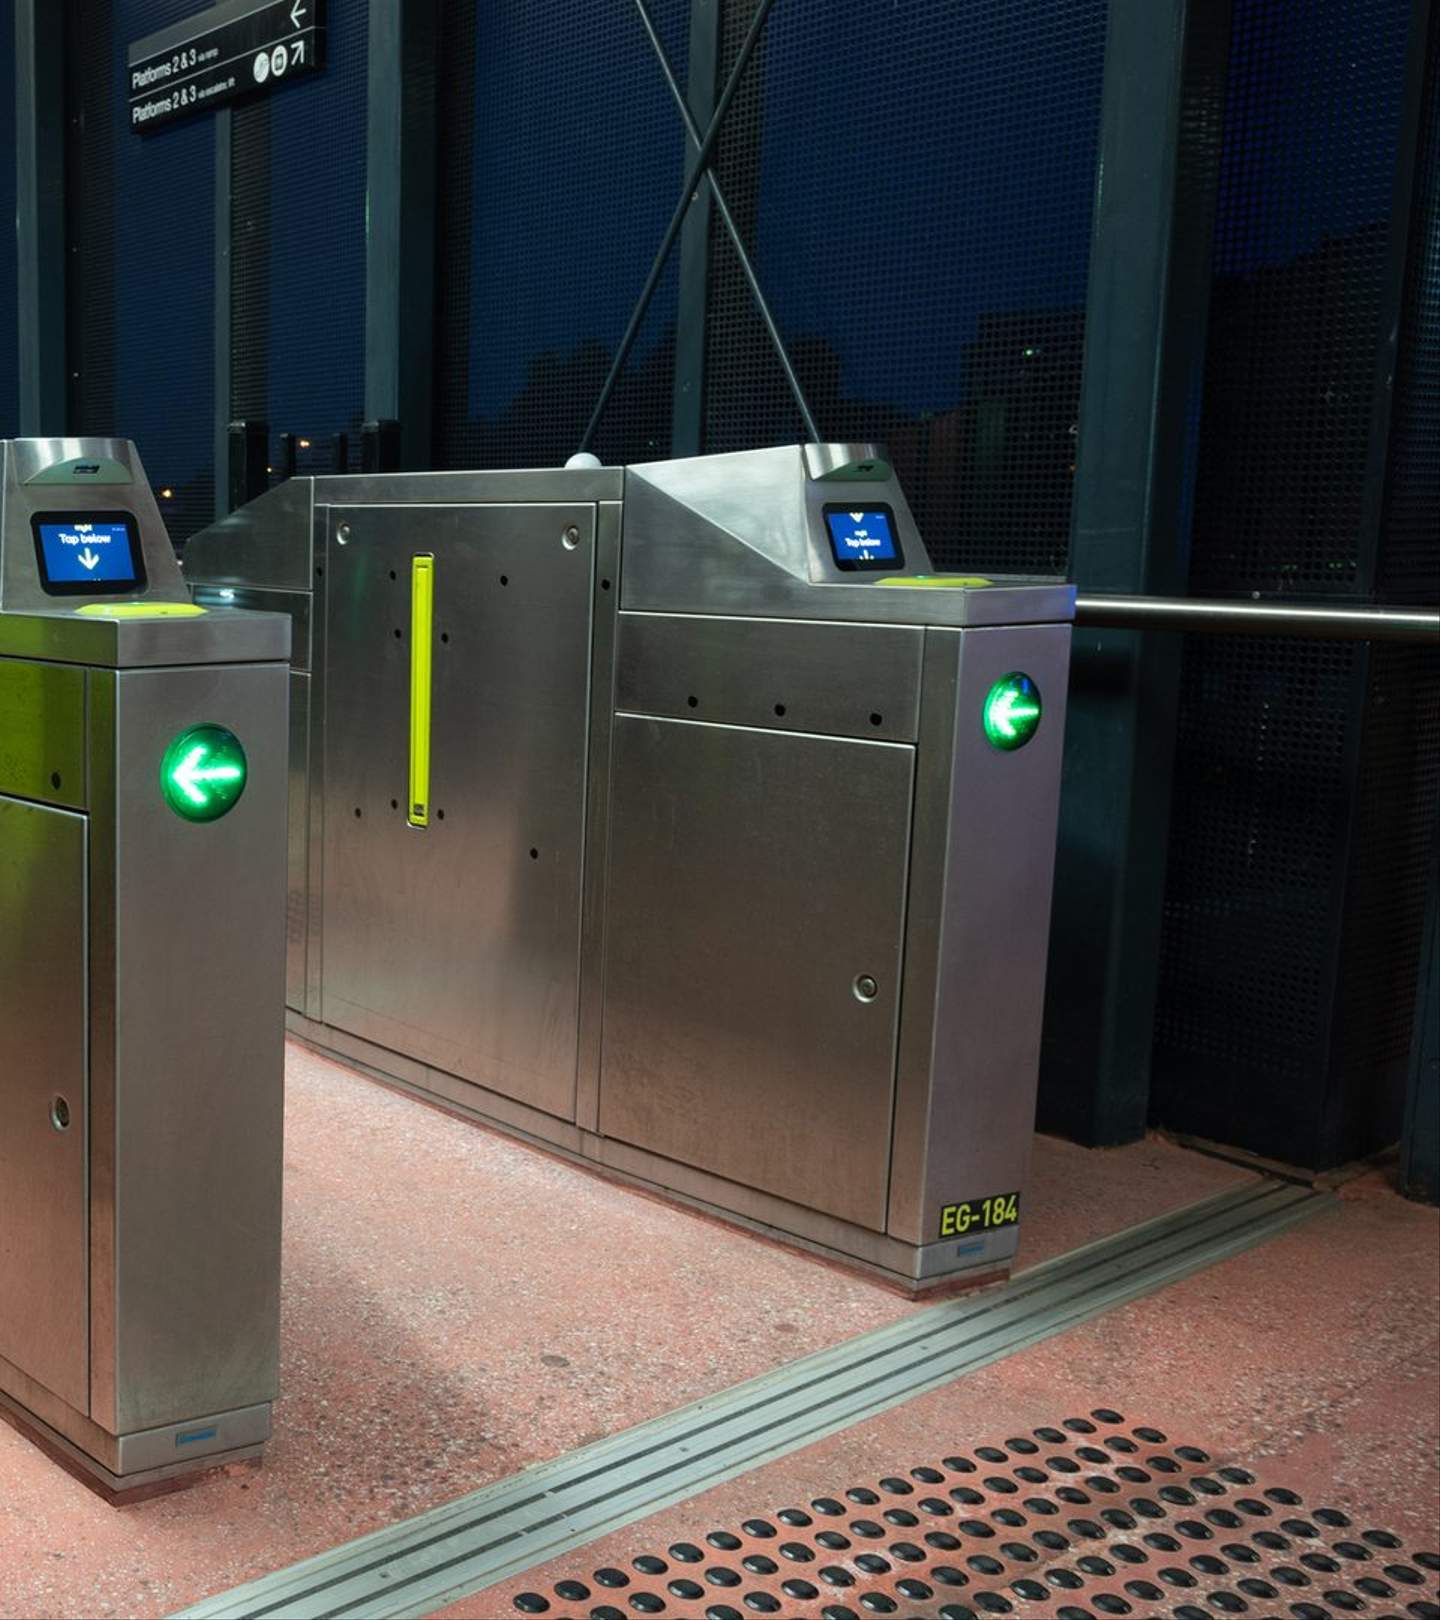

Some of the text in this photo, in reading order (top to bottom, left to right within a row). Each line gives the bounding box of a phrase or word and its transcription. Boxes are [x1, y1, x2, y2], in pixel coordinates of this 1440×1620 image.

[132, 63, 171, 89] Platforms
[172, 56, 180, 73] 2
[180, 52, 188, 69] &
[189, 48, 196, 65] 3
[132, 98, 171, 124] Platforms
[172, 92, 180, 109] 2
[180, 88, 188, 105] &
[189, 85, 196, 102] 3
[58, 533, 111, 546] Tap below
[942, 1195, 1017, 1236] EG-184
